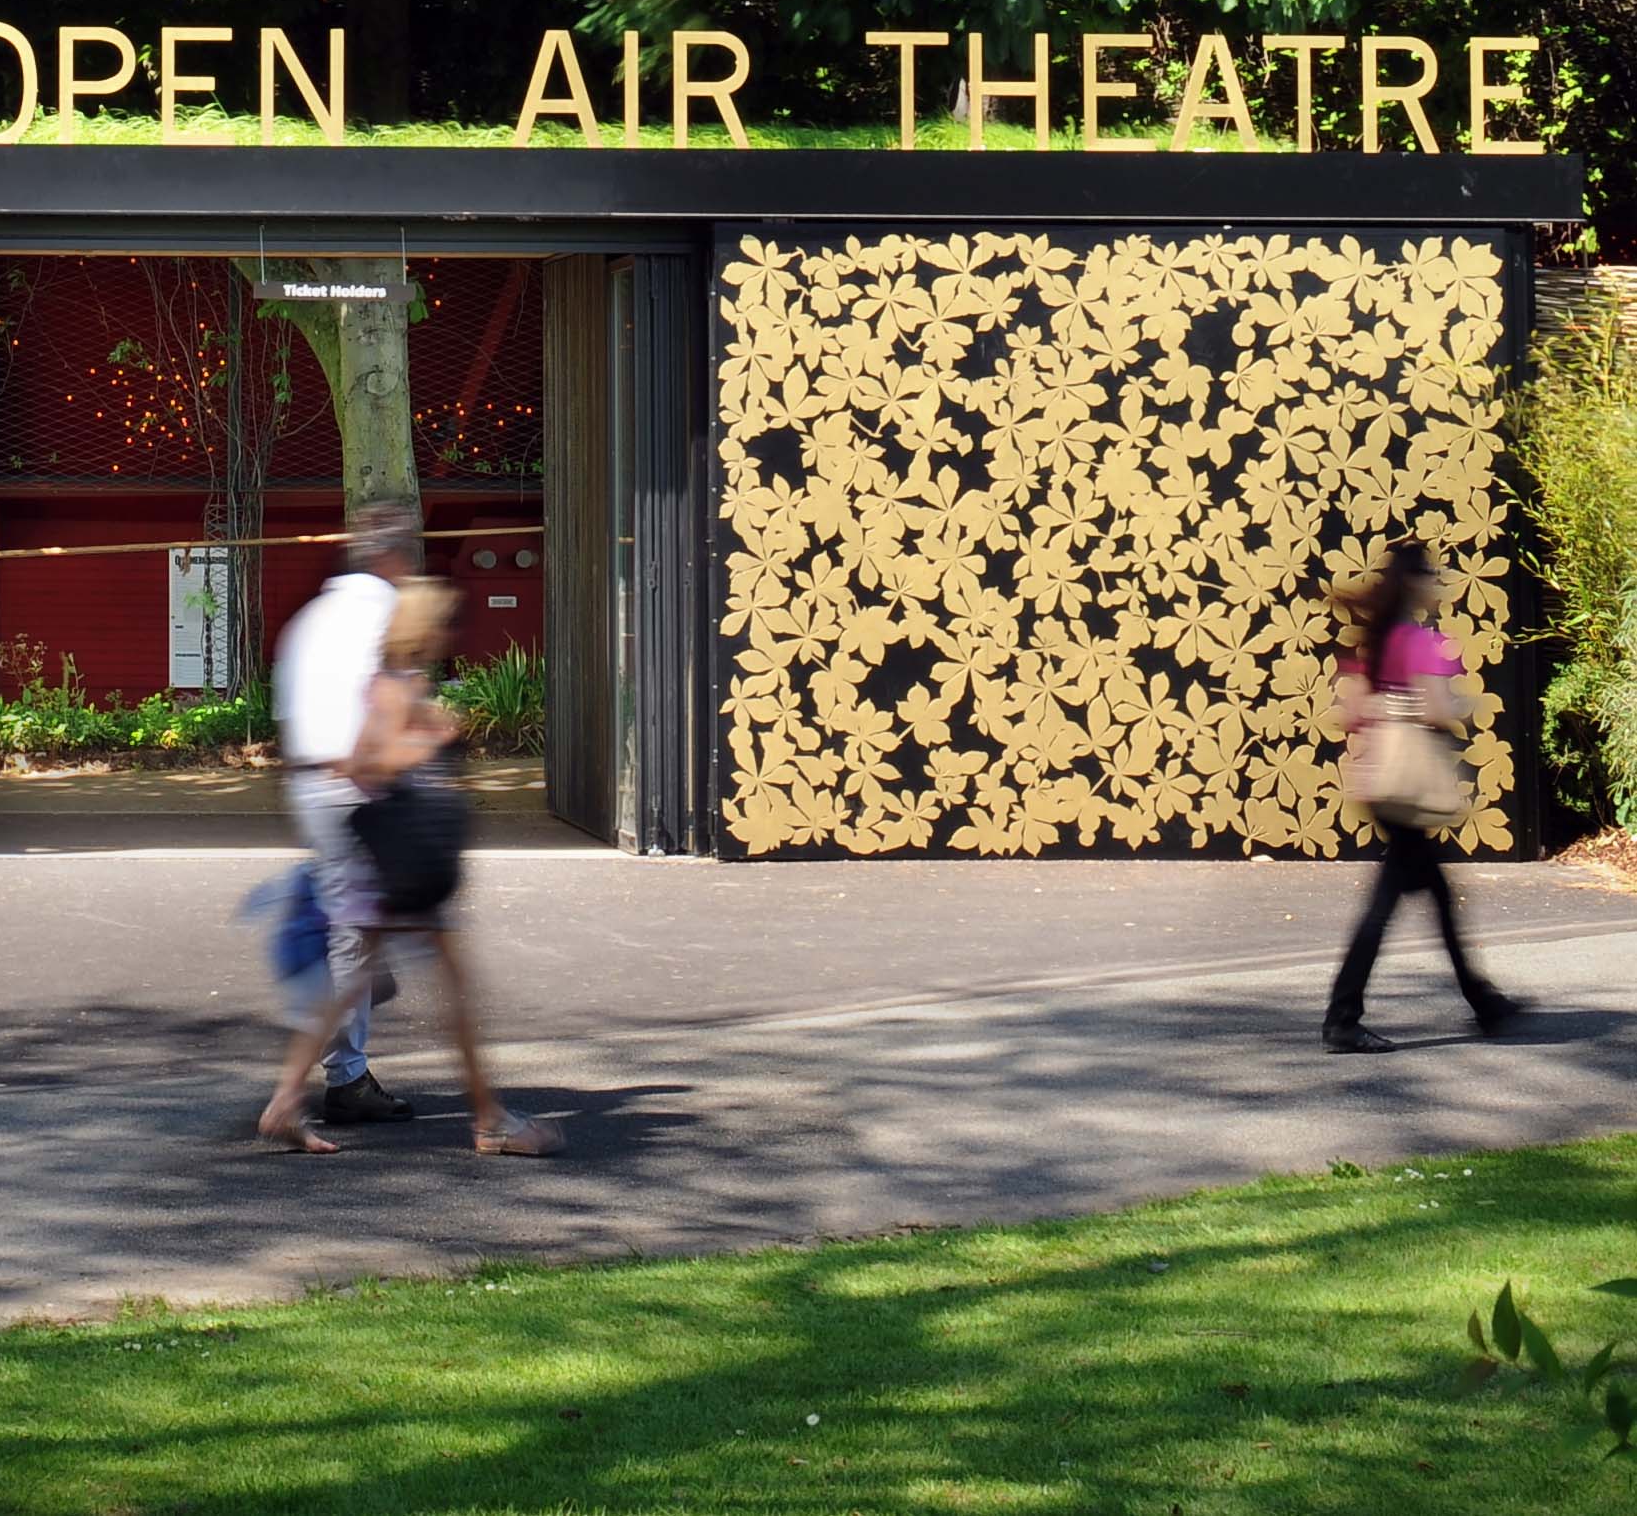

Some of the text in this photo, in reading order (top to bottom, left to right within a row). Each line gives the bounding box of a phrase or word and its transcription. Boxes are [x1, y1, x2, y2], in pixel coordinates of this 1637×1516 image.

[513, 29, 751, 149] AIR
[864, 31, 1546, 156] THEATRE
[282, 283, 387, 298] Ticket Holders
